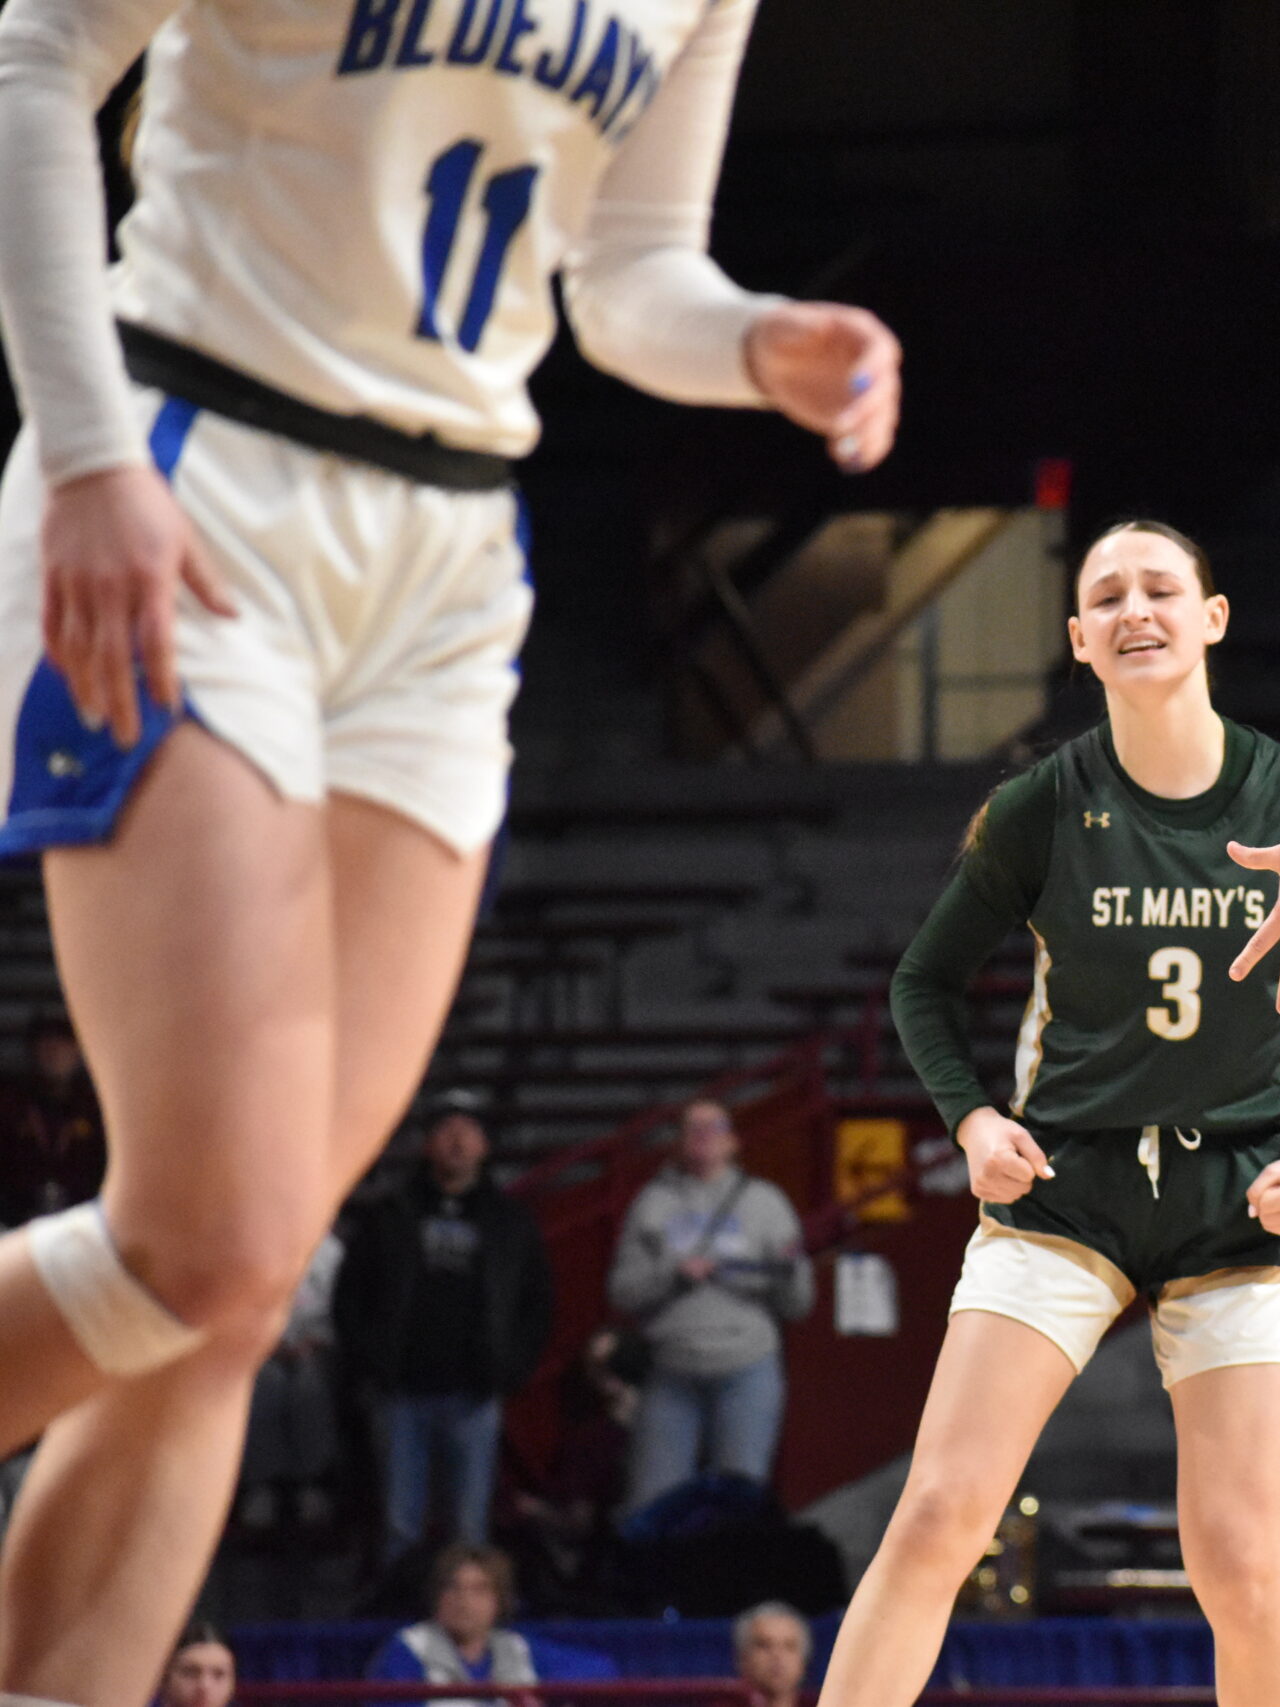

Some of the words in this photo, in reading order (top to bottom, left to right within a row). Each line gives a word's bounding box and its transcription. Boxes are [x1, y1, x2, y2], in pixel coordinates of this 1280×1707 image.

[413, 137, 541, 355] 11
[1092, 887, 1134, 927] ST.
[1141, 886, 1265, 929] MARY'S
[1146, 946, 1203, 1041] 3
